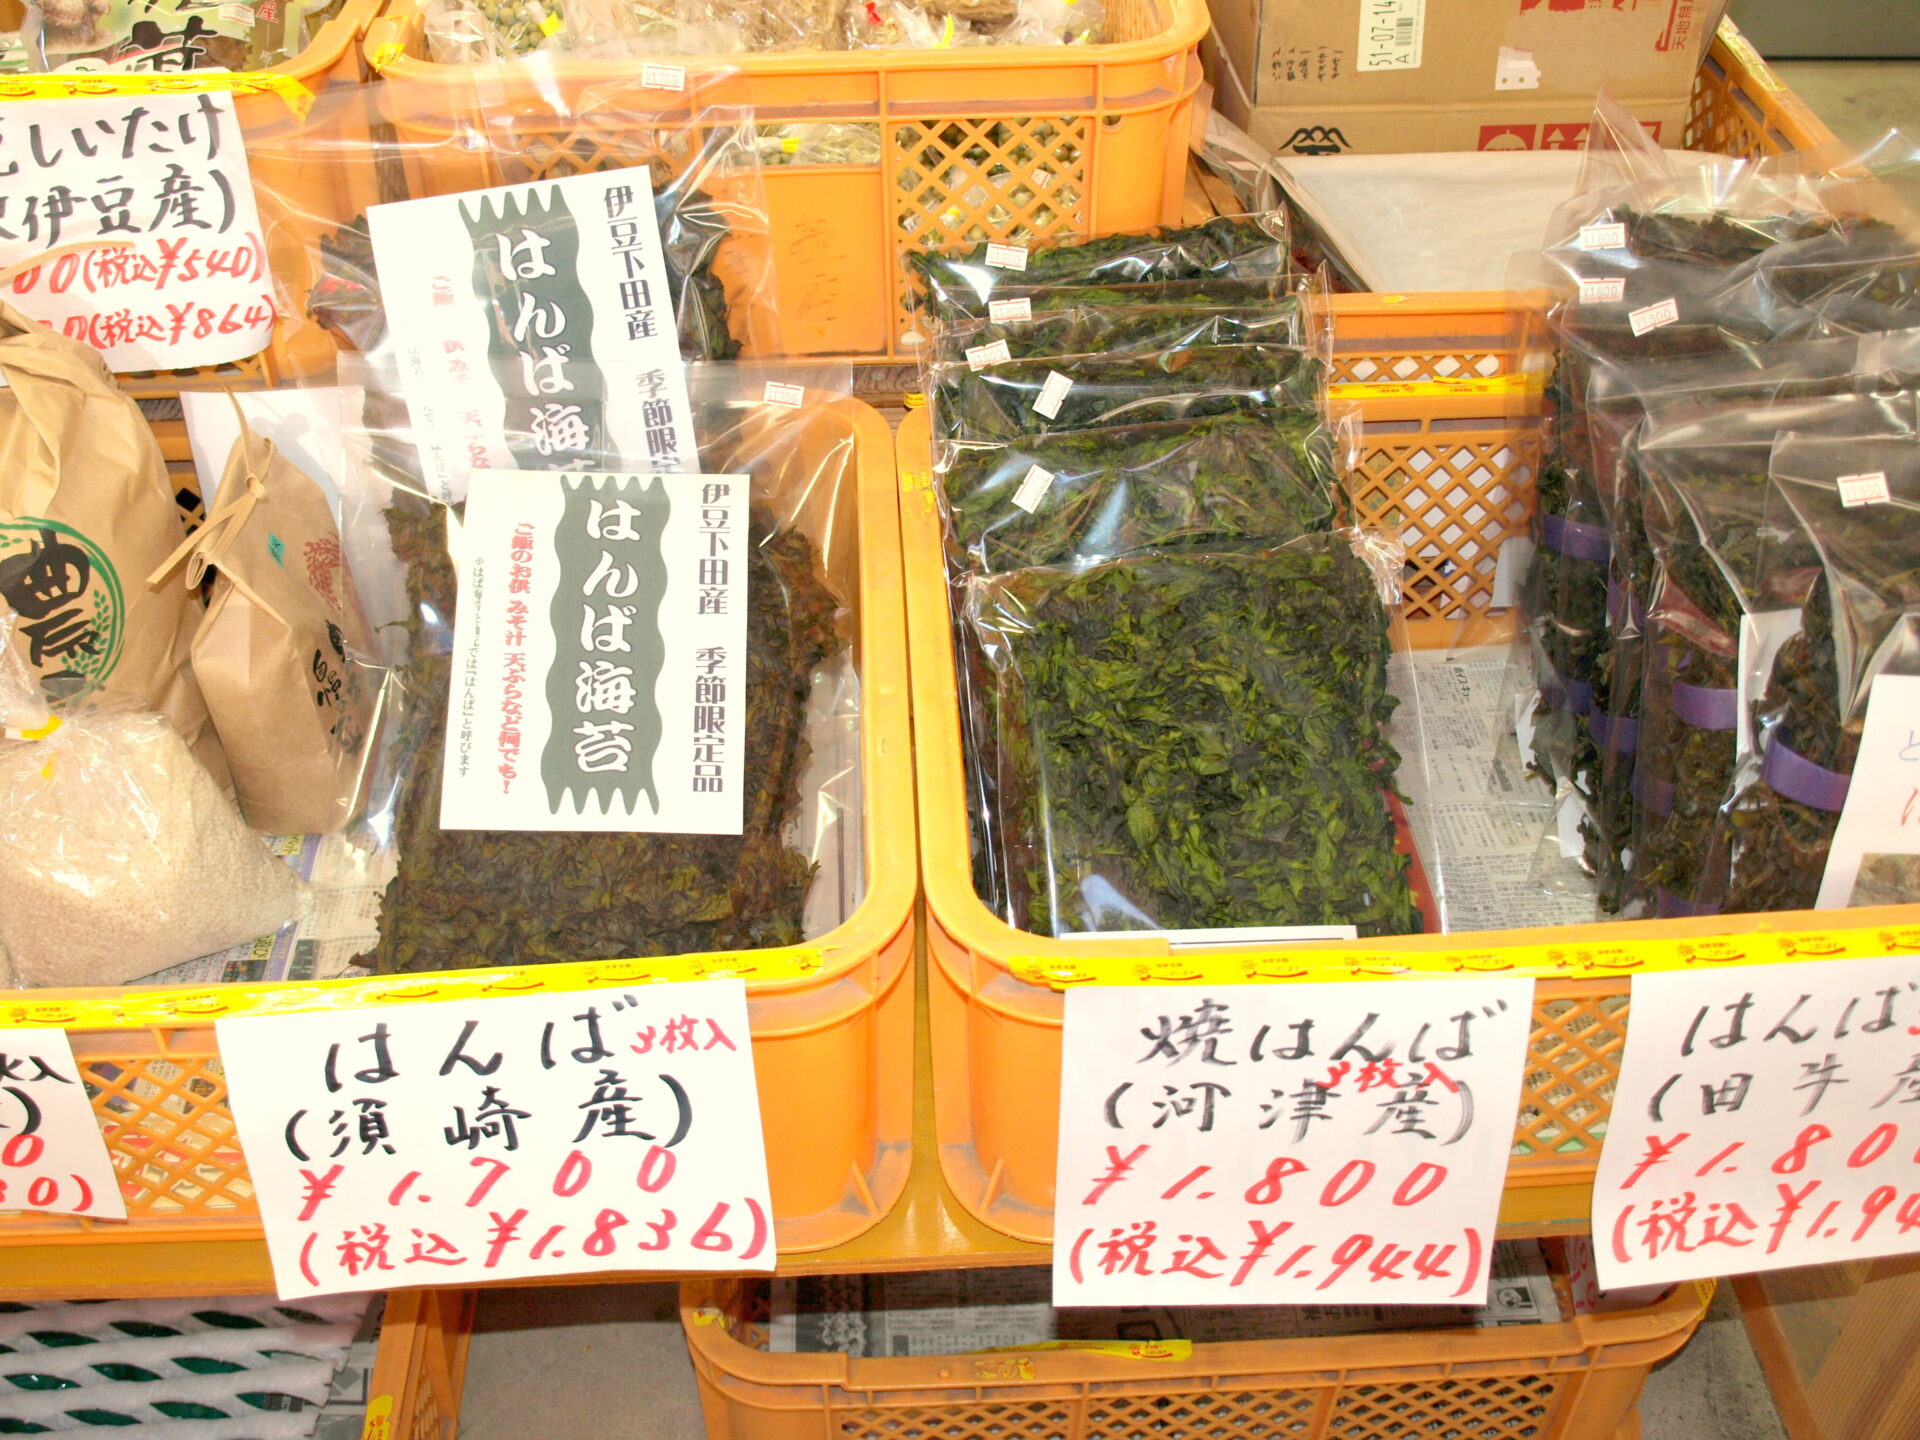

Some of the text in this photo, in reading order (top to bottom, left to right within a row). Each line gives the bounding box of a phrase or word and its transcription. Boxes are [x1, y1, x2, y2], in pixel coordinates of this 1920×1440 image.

[1369, 0, 1396, 66] 51-07-14
[1672, 0, 1694, 50] 天地無
[603, 185, 658, 341] 伊豆下田産
[508, 523, 535, 594] ご飯のお供
[697, 483, 731, 615] 伊豆下田産
[505, 600, 528, 646] みそ汁
[573, 499, 641, 773] はんば海苔
[692, 646, 727, 793] 季節限定品
[324, 994, 638, 1092] はんば
[1136, 998, 1509, 1067] 焼はんば
[285, 1069, 693, 1161] (須崎産)
[1619, 1123, 1920, 1190] ¥1.80
